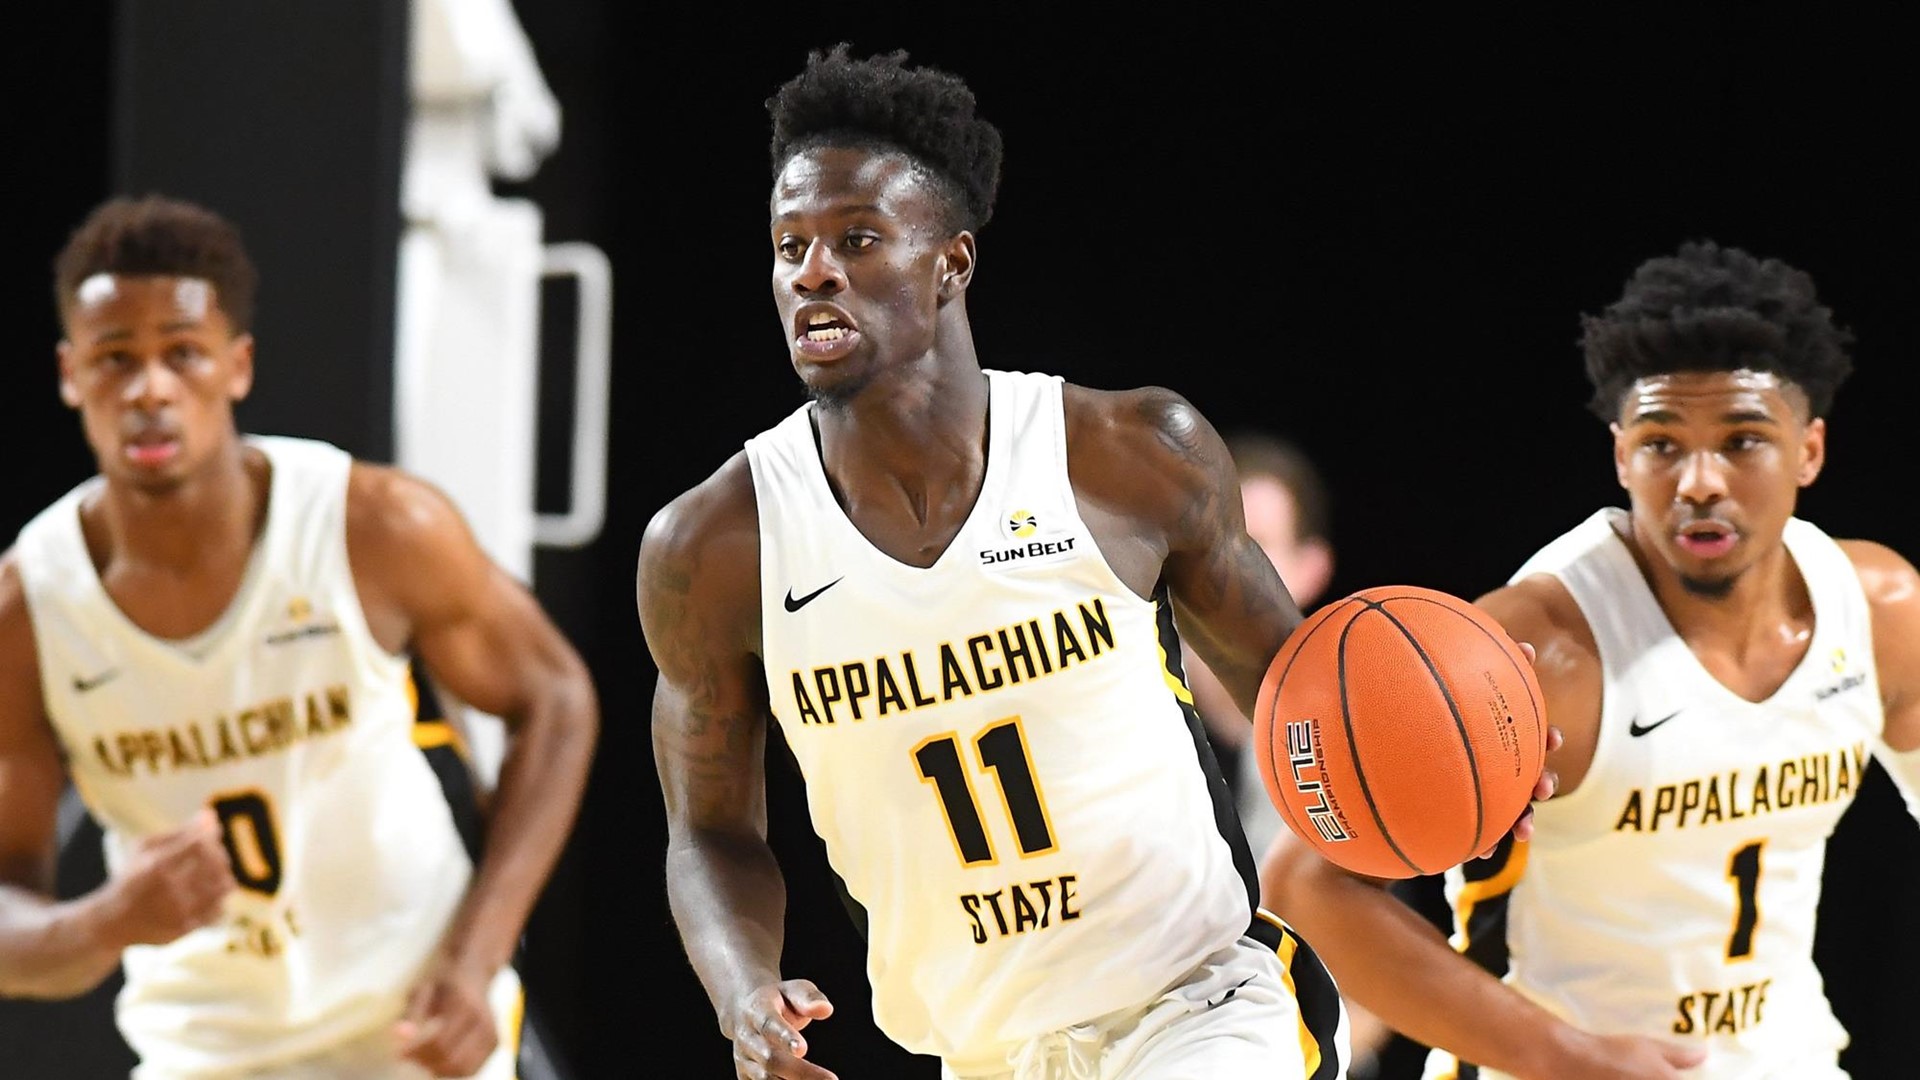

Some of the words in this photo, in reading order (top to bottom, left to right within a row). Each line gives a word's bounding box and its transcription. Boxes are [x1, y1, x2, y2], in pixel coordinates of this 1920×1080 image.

[980, 547, 1025, 565] SUN
[1027, 537, 1075, 557] BELT
[791, 597, 1115, 726] APPALACHIAN
[909, 714, 1060, 869] 11
[1286, 720, 1351, 843] ELITE
[1312, 718, 1358, 840] CHAMPIONSHIP
[210, 785, 283, 899] 0
[1725, 836, 1769, 964] 1
[960, 874, 1082, 945] STATE
[1673, 978, 1773, 1037] STATE
